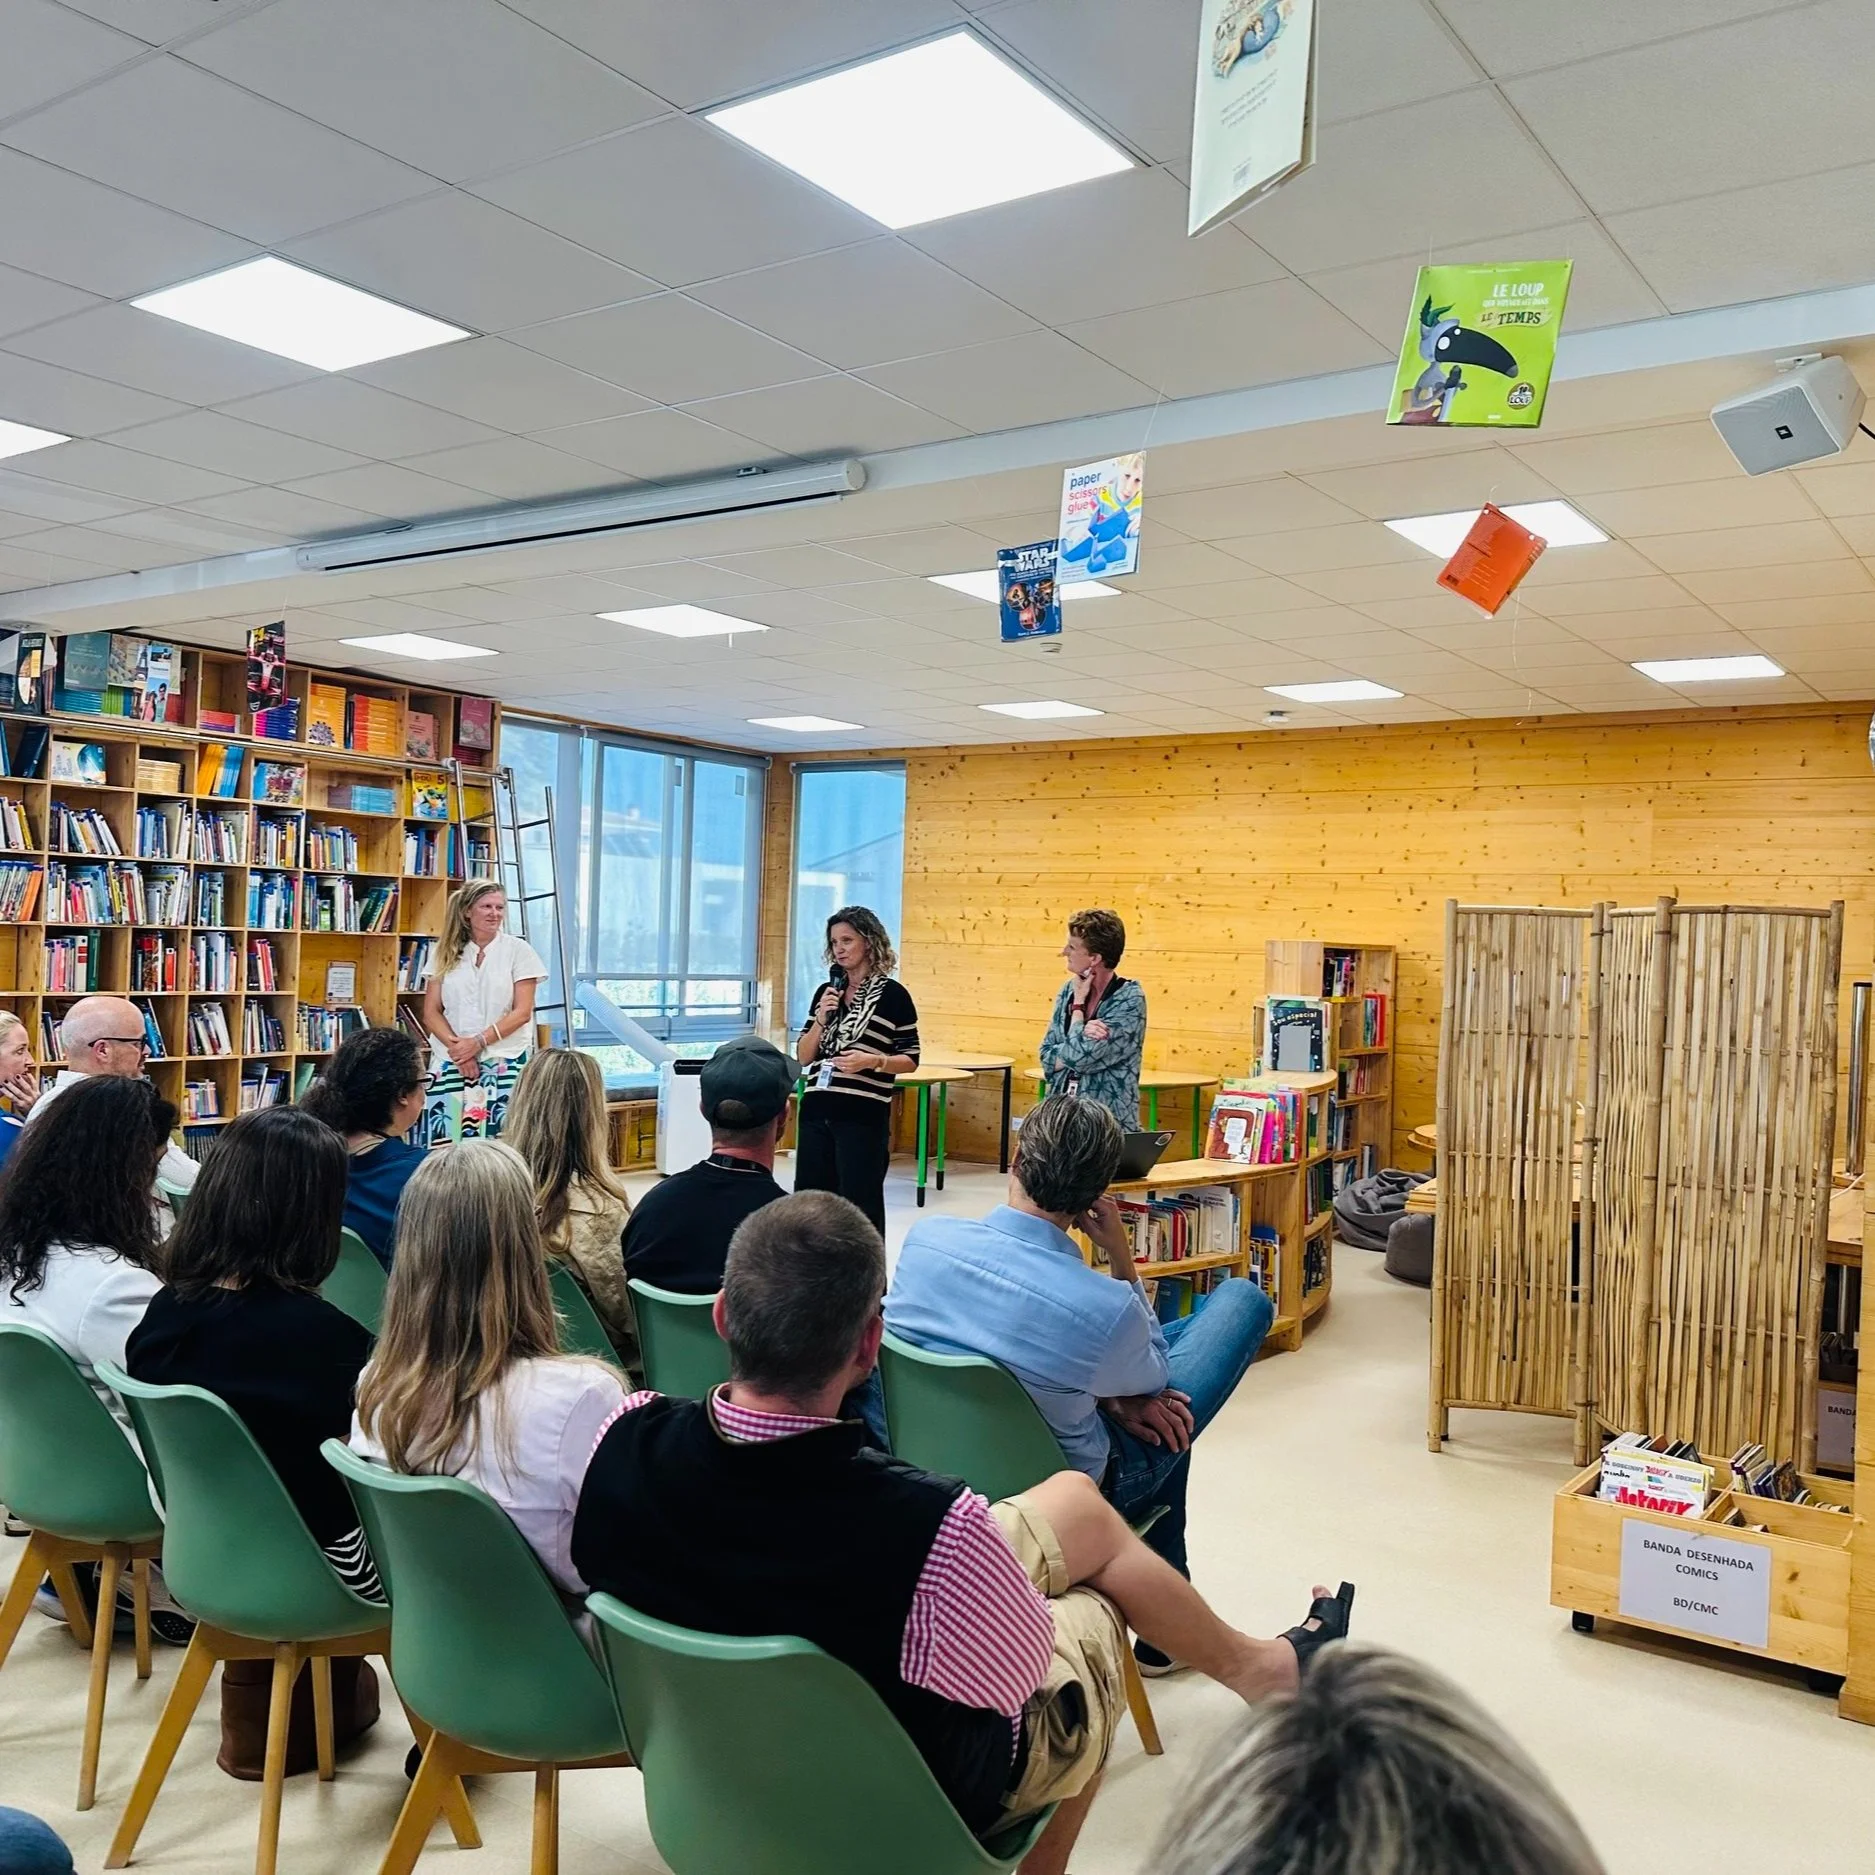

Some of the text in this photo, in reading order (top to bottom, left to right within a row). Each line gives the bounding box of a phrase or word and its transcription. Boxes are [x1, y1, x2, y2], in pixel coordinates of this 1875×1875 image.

[1493, 282, 1544, 297] LE LOUP
[1498, 311, 1541, 325] TEMPS
[1070, 472, 1101, 490] paper
[1069, 485, 1107, 501] scissors
[1067, 501, 1089, 515] glue
[1016, 547, 1049, 562] STAR
[1014, 557, 1050, 573] WARS
[1643, 1539, 1754, 1572] BANDA DESENHADA
[1675, 1564, 1719, 1581] COMICS
[1673, 1597, 1719, 1616] BD/CMC
